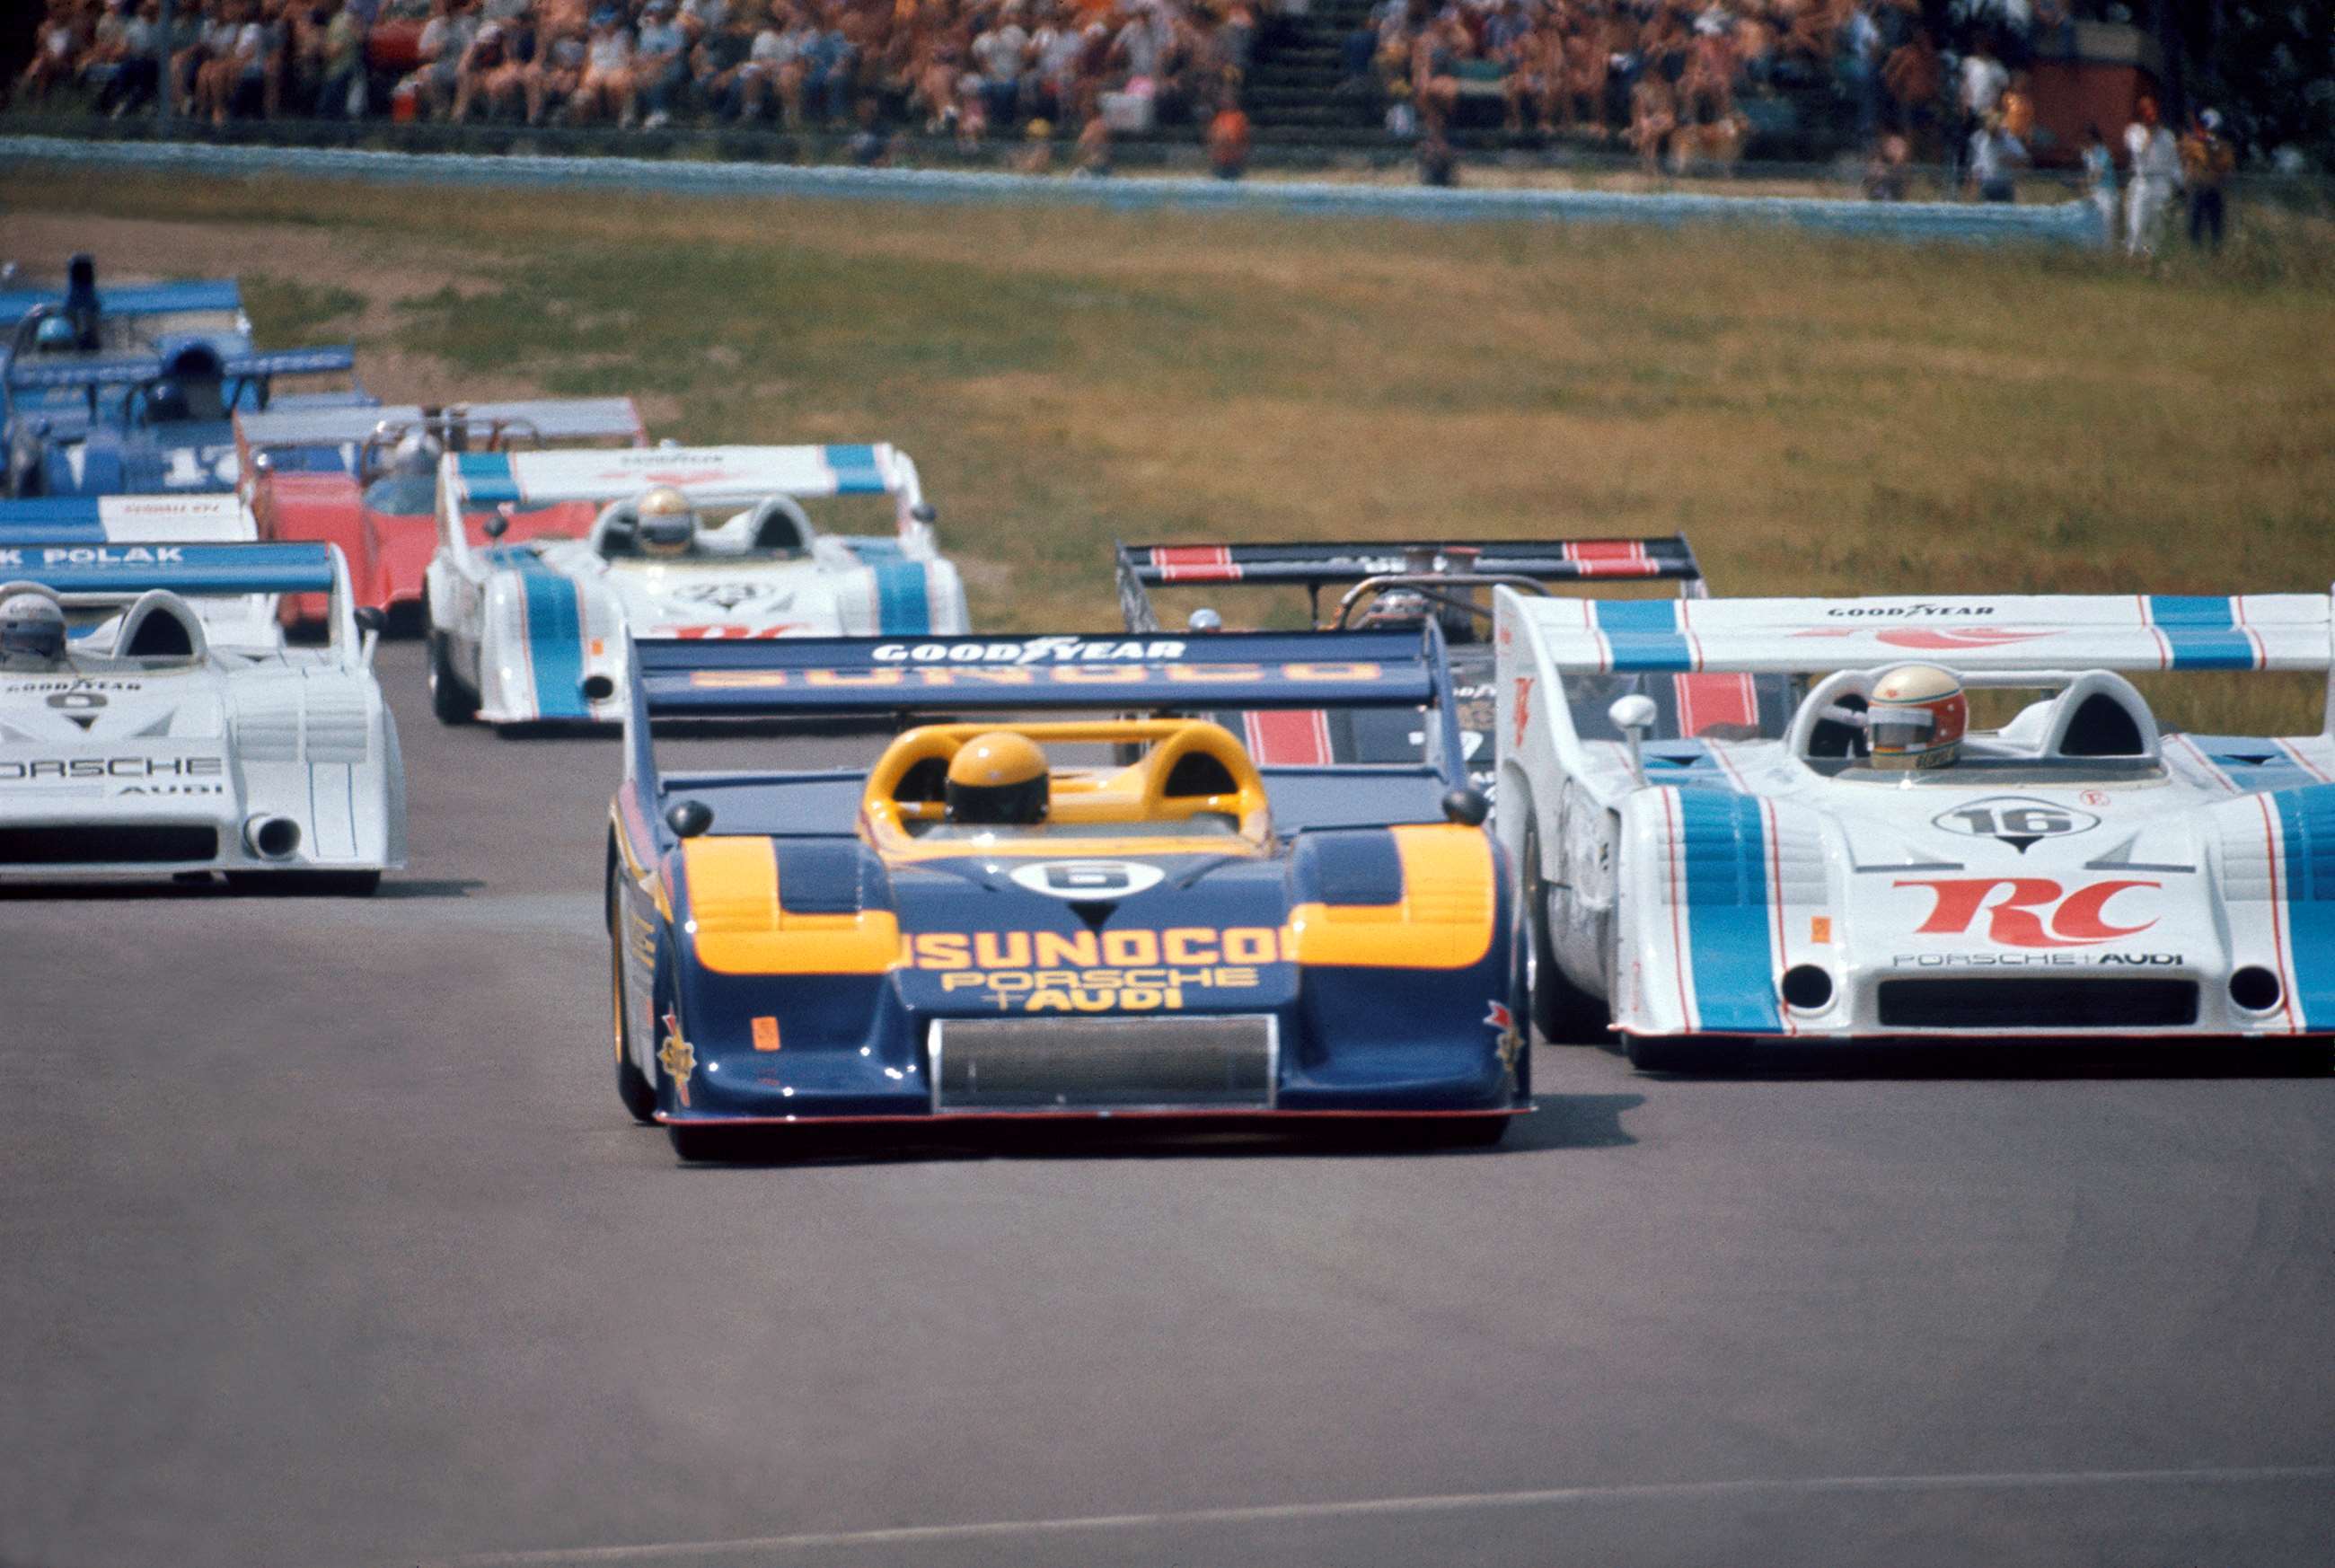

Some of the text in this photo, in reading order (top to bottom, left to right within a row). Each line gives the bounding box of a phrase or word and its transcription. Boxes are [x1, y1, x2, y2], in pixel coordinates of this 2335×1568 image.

[43, 547, 183, 563] POLAK
[1827, 603, 1996, 619] GOODYEAR
[870, 637, 1186, 667] GOODYEAR
[117, 784, 223, 796] AUDI
[1952, 807, 2073, 834] 16
[1043, 865, 1131, 889] 6
[1892, 877, 2163, 947] RC
[914, 927, 1279, 970] SUNOCO
[1892, 953, 2075, 967] PORSCHE
[940, 967, 1260, 992] PORSCHE
